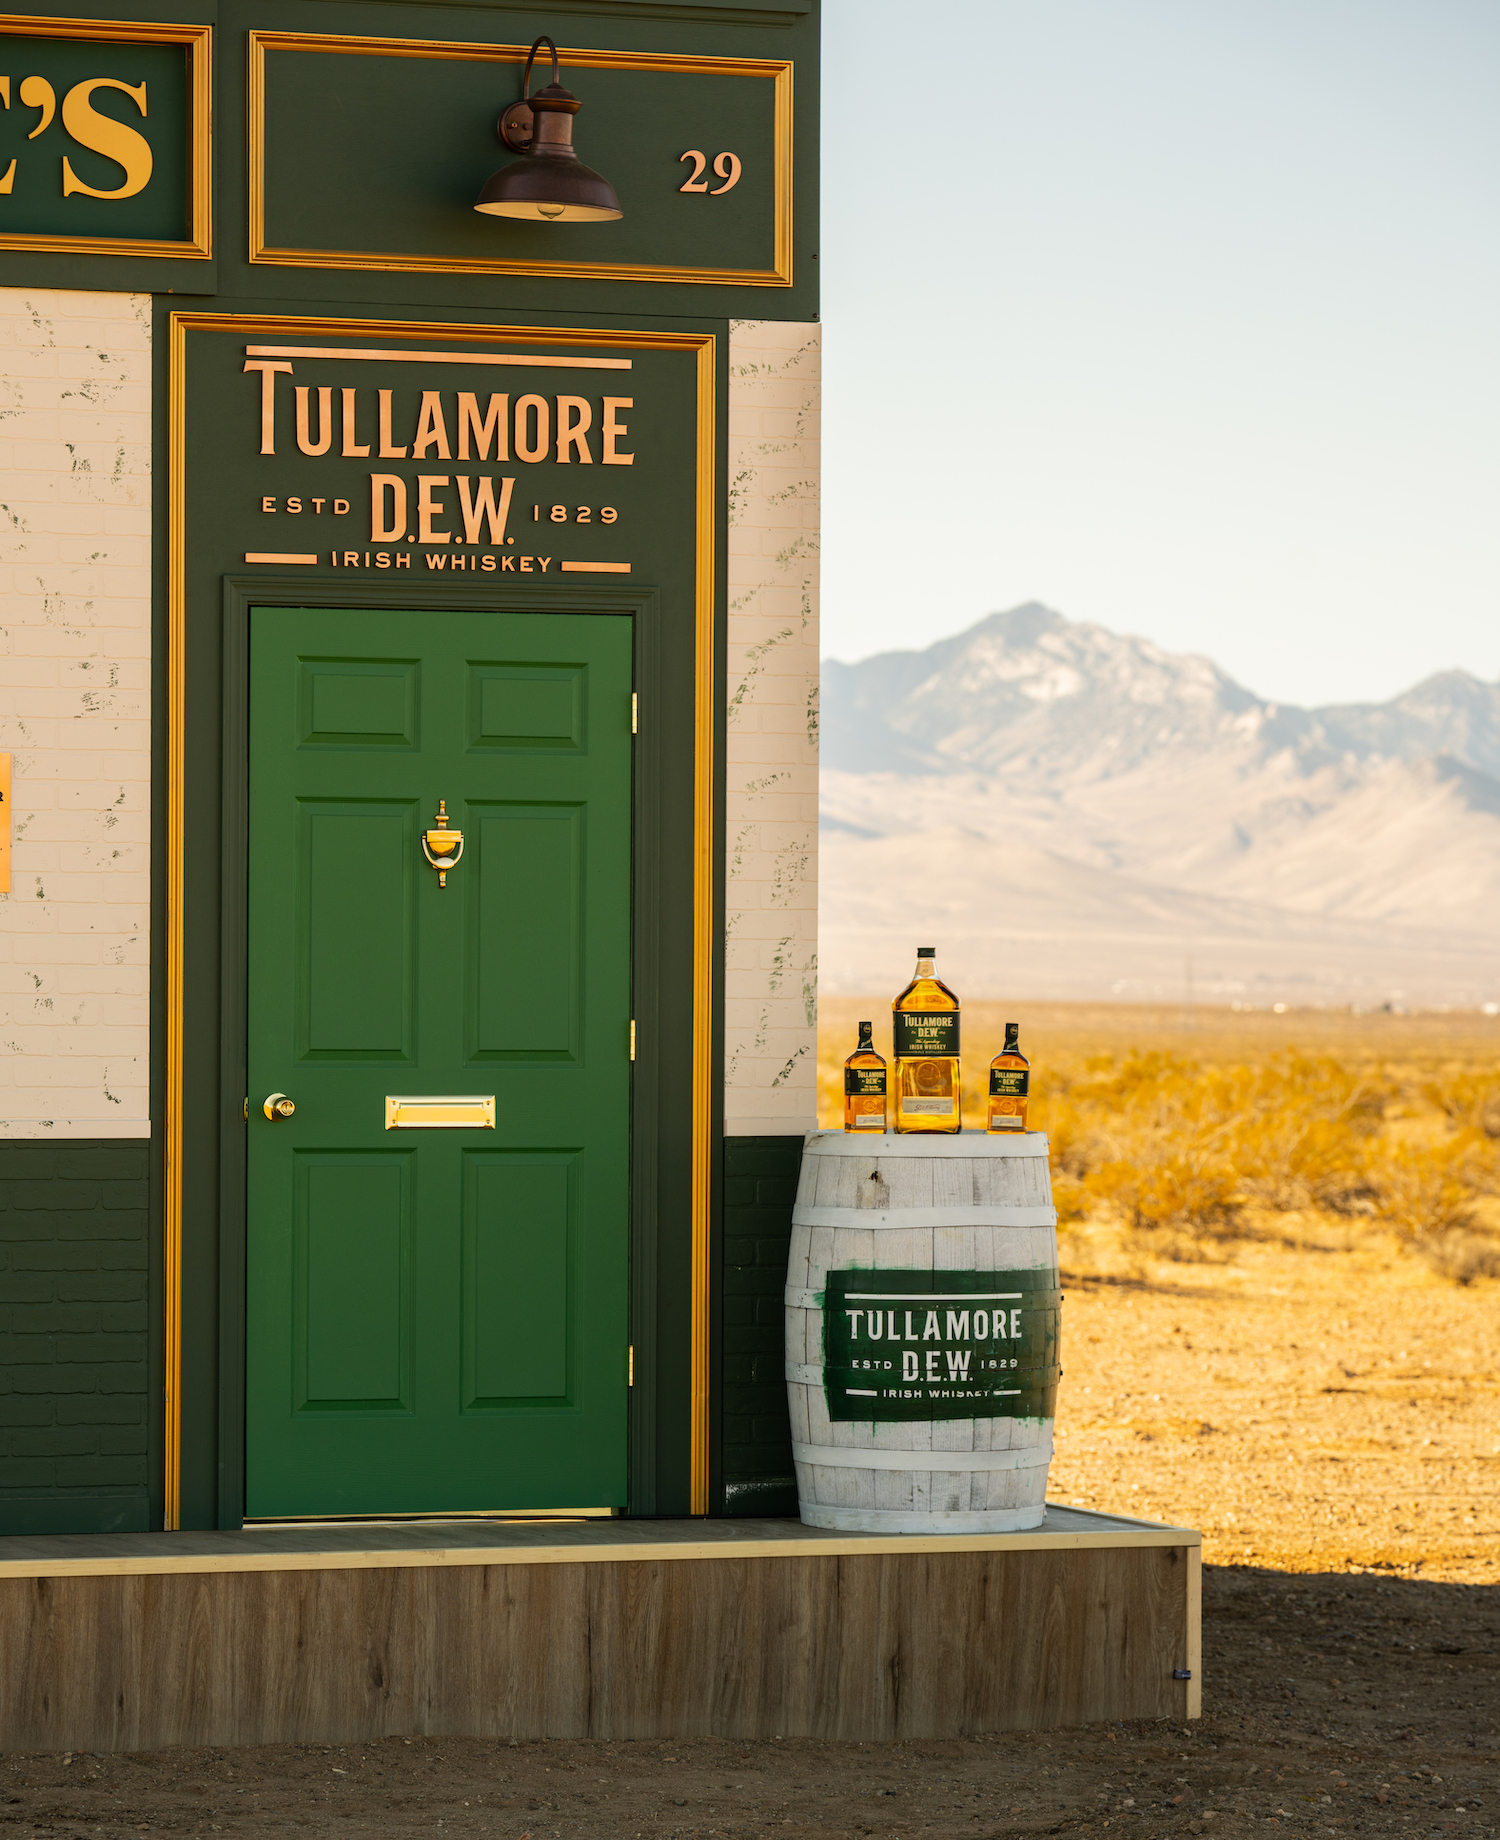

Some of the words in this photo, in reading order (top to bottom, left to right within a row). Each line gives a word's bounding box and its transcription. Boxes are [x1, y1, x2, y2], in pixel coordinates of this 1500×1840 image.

[0, 75, 154, 200] 'S
[679, 149, 743, 196] 29
[243, 359, 635, 466] TULLAMORE
[262, 496, 351, 515] ESTD
[370, 473, 516, 546] D.E.W.
[532, 504, 619, 524] 1829
[331, 550, 412, 570] IRISH
[425, 553, 552, 573] WHISKEY
[902, 1014, 953, 1027] TULLAMORE
[845, 1309, 1022, 1341] TULLAMORE
[852, 1359, 893, 1370] ESTD
[902, 1350, 974, 1382] D.E.W.
[980, 1358, 1018, 1370] 1829
[883, 1389, 922, 1399] IRISH
[928, 1389, 989, 1399] WHISKEY
